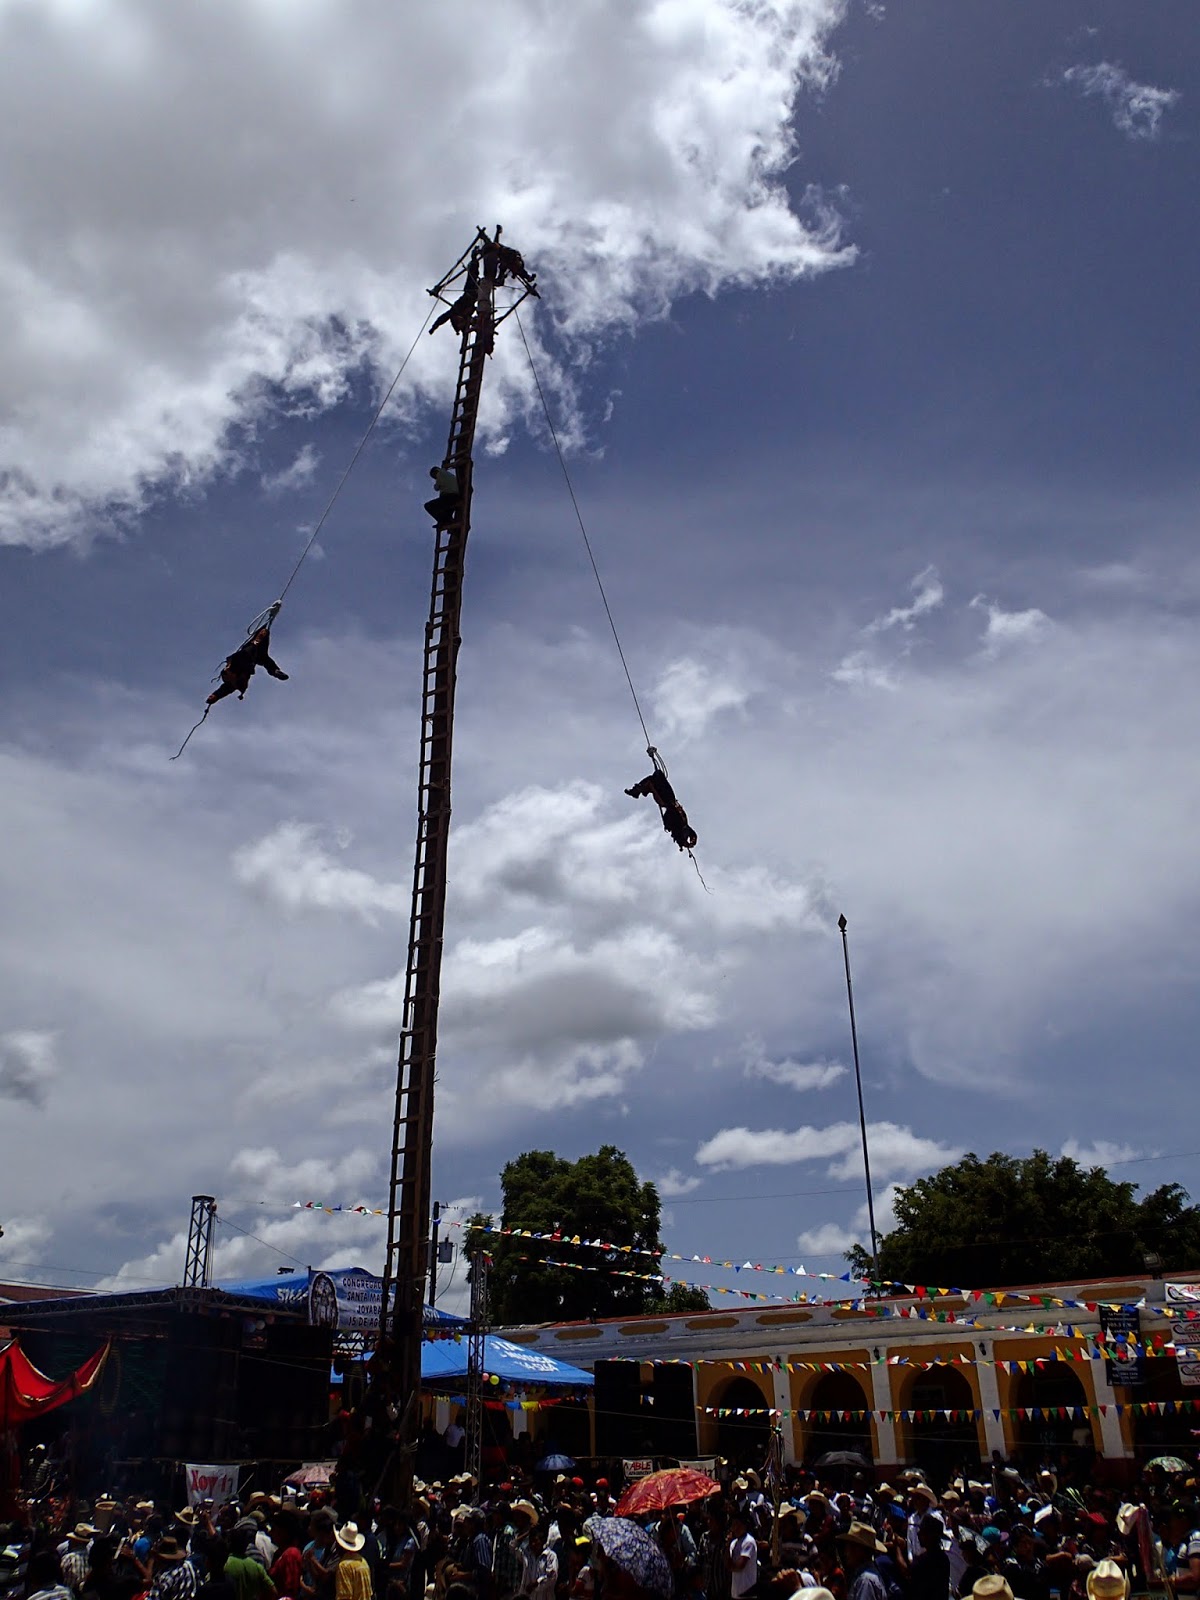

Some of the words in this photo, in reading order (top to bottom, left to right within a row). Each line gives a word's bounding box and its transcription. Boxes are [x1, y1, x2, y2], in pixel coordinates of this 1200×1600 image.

[342, 1277, 393, 1292] CONGREGAC
[346, 1291, 368, 1302] SANTA
[356, 1305, 384, 1315] JOYABA
[358, 1317, 368, 1327] DE
